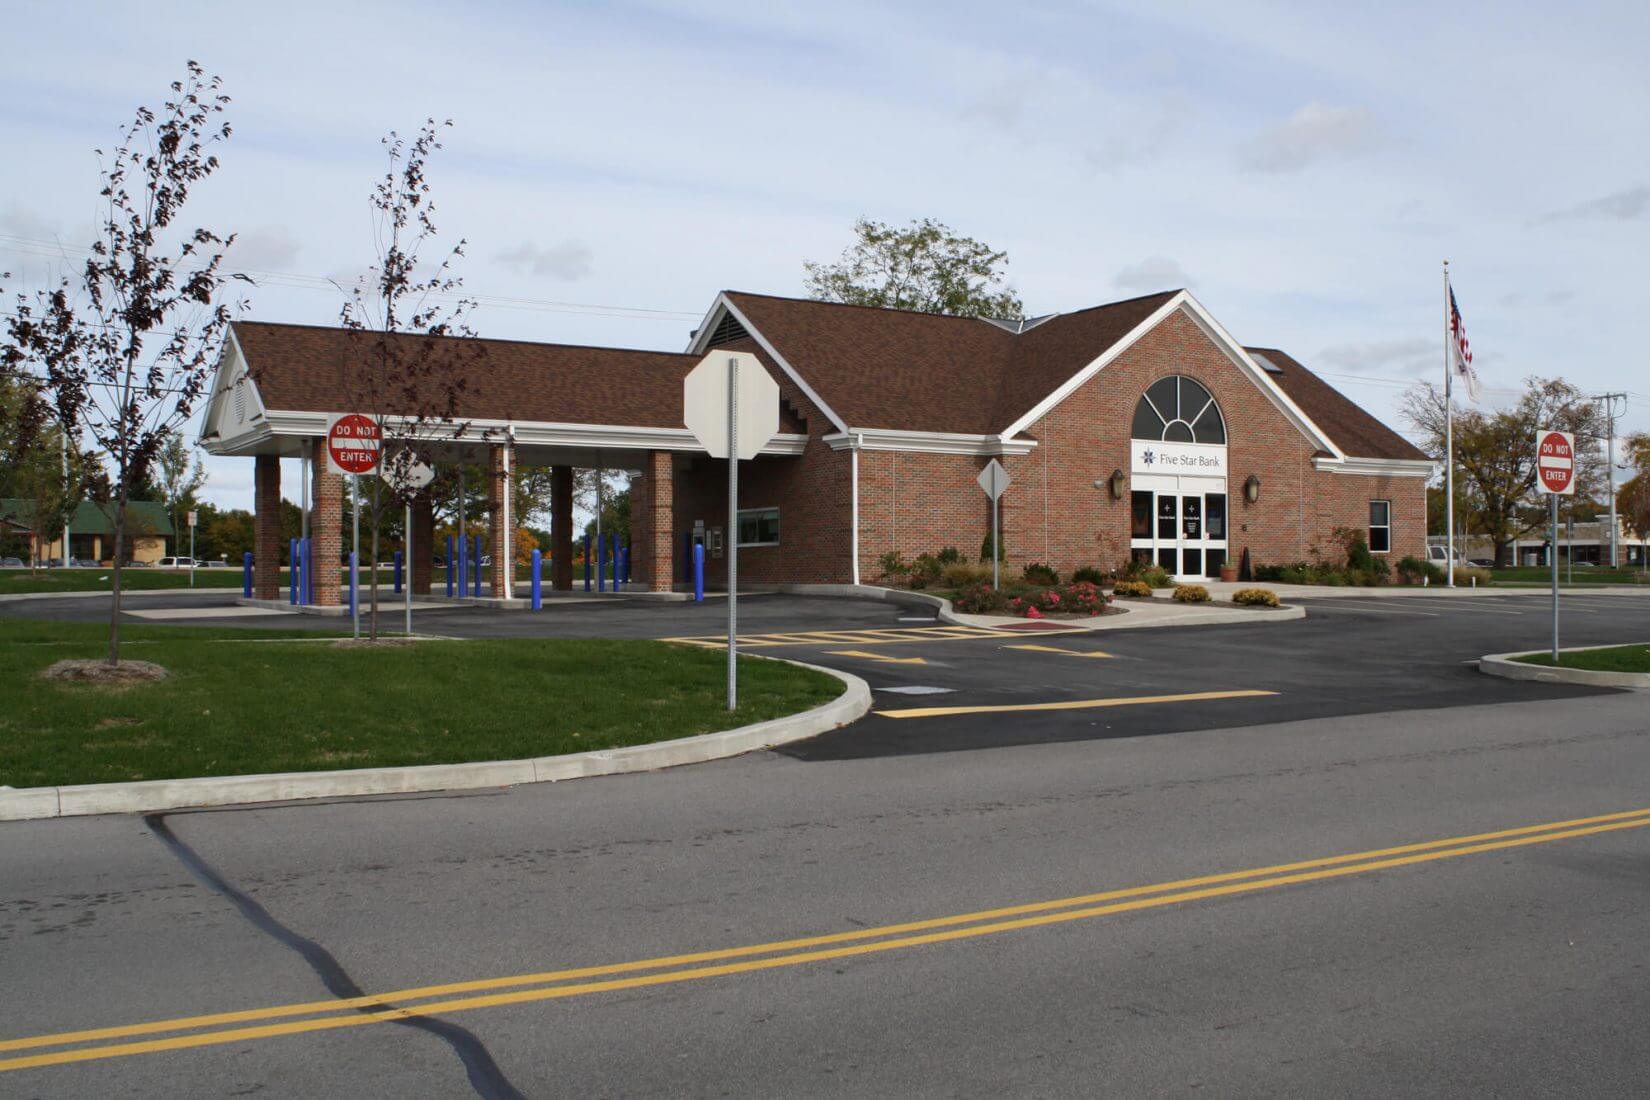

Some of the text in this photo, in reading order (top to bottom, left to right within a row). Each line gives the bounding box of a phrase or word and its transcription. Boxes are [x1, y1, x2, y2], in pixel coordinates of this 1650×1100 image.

[336, 425, 376, 436] DO NOT
[1543, 444, 1568, 455] DO NOT
[340, 452, 372, 462] ENTER
[1160, 454, 1220, 467] Five Star Bank
[1546, 471, 1566, 480] ENTER
